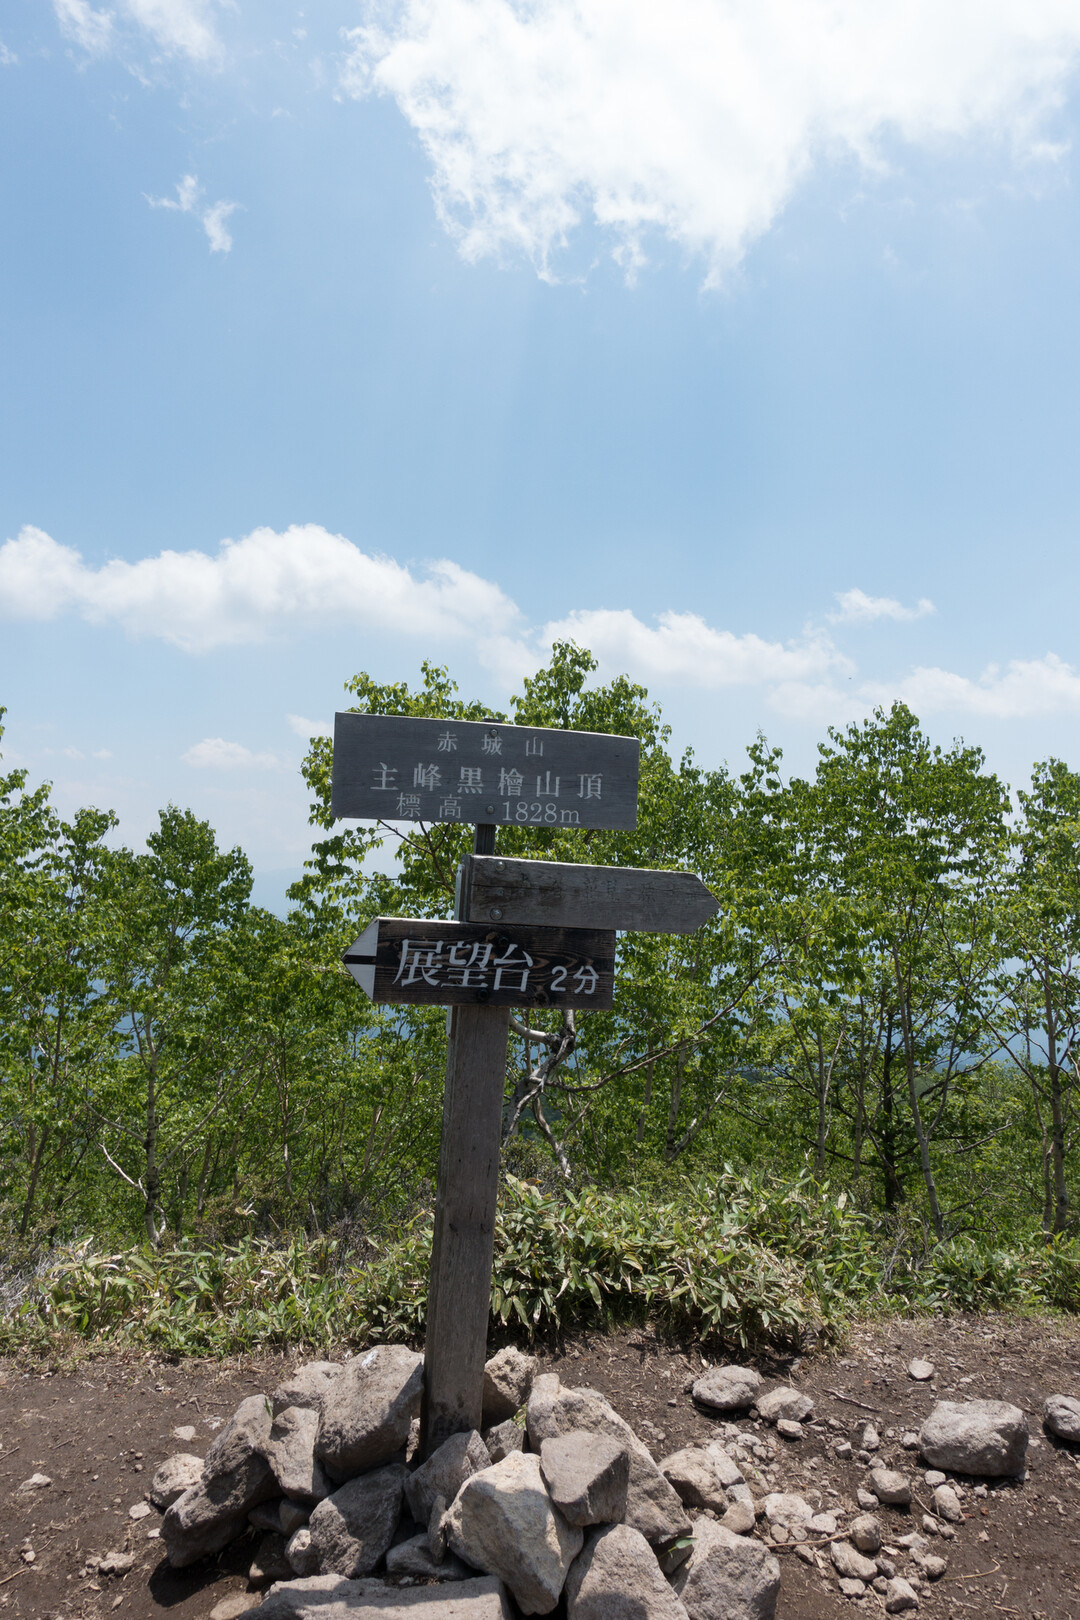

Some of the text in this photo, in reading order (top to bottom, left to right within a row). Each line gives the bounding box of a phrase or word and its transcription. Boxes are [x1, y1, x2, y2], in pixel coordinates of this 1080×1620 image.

[437, 731, 544, 757] 赤城山
[369, 762, 603, 800] 主峰黒檜山頂
[396, 792, 581, 824] 標高 1828m
[393, 938, 599, 994] 展望台 2分
